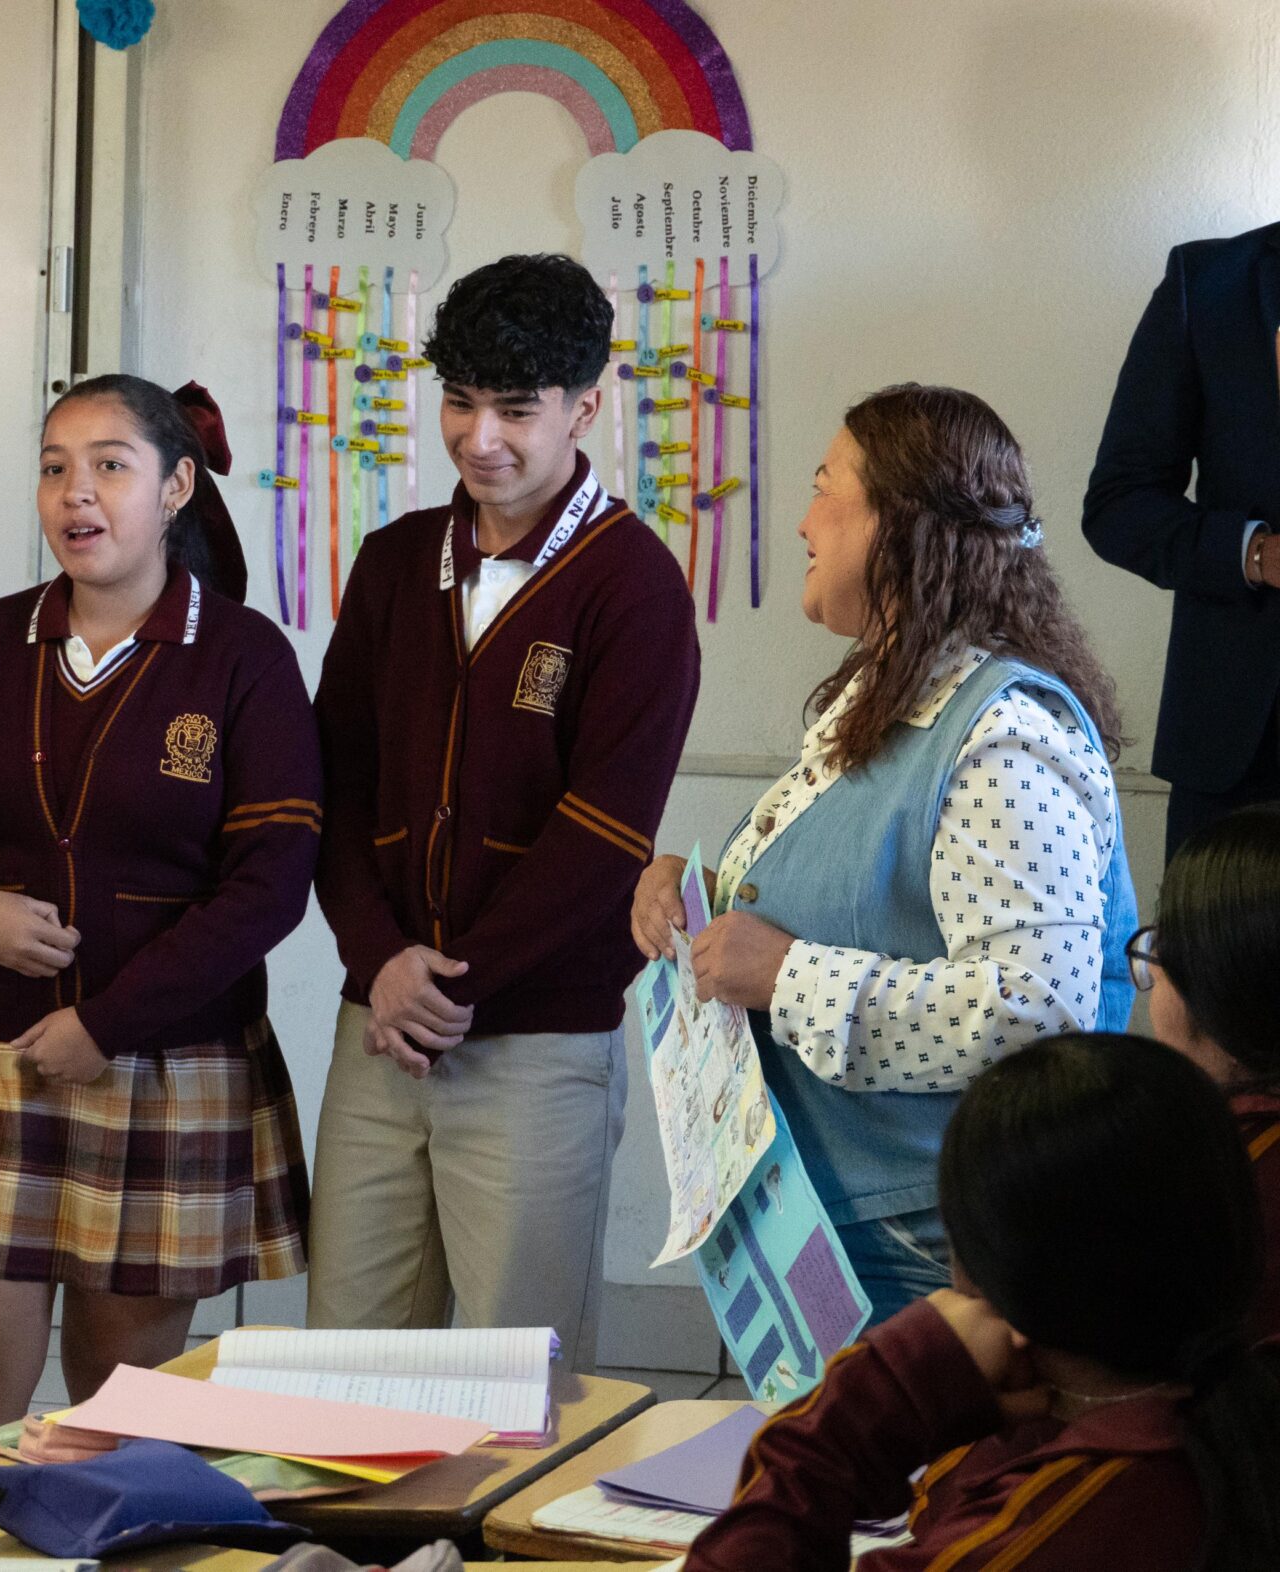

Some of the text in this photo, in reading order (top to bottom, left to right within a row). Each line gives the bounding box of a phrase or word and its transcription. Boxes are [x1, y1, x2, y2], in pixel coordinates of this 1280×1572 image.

[279, 192, 292, 231] Enero
[307, 192, 320, 243] Febrero
[337, 199, 349, 239] Marzo
[365, 201, 376, 234] Abril
[386, 203, 399, 239] Mayo
[416, 203, 426, 240] Junio
[611, 196, 622, 230] Julio
[633, 193, 646, 238] Agosto
[662, 182, 676, 258] Septiembre
[692, 190, 703, 243] Octubre
[719, 176, 732, 248] Noviembre
[747, 175, 758, 244] Diciembre
